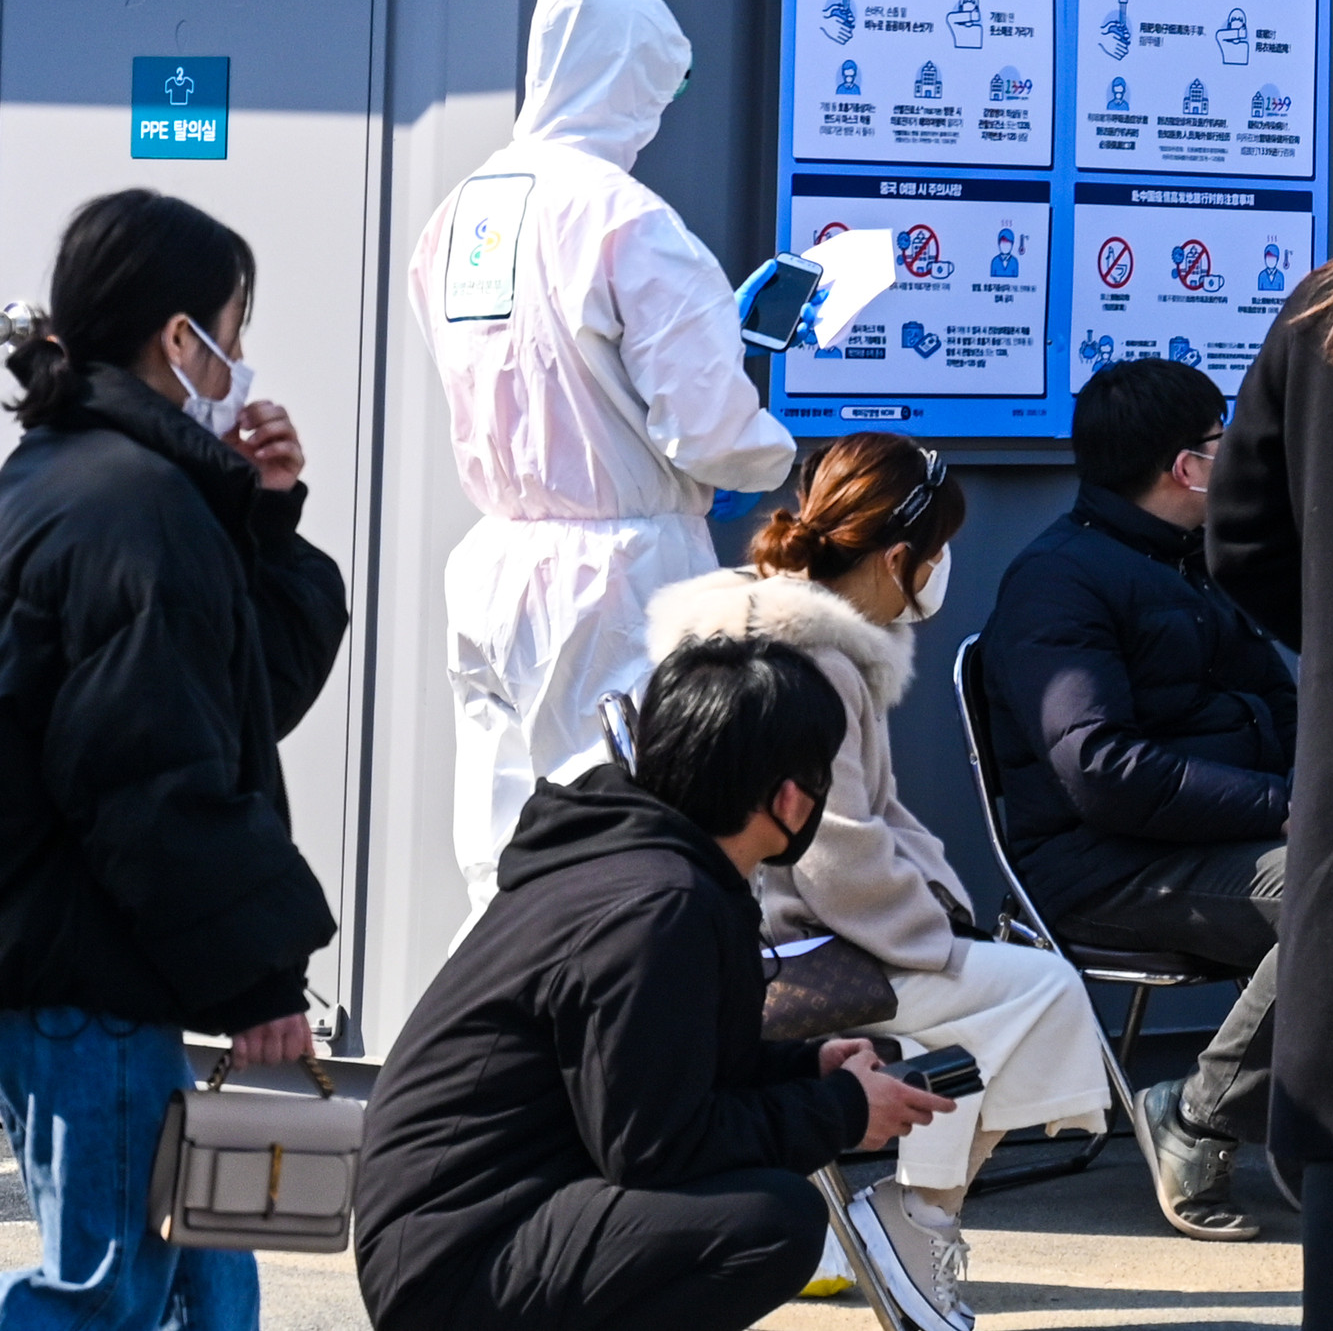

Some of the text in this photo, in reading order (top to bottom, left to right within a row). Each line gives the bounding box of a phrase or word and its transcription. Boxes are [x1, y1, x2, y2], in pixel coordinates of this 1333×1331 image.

[141, 119, 216, 141] PPE 탈의실
[917, 183, 927, 196] 시
